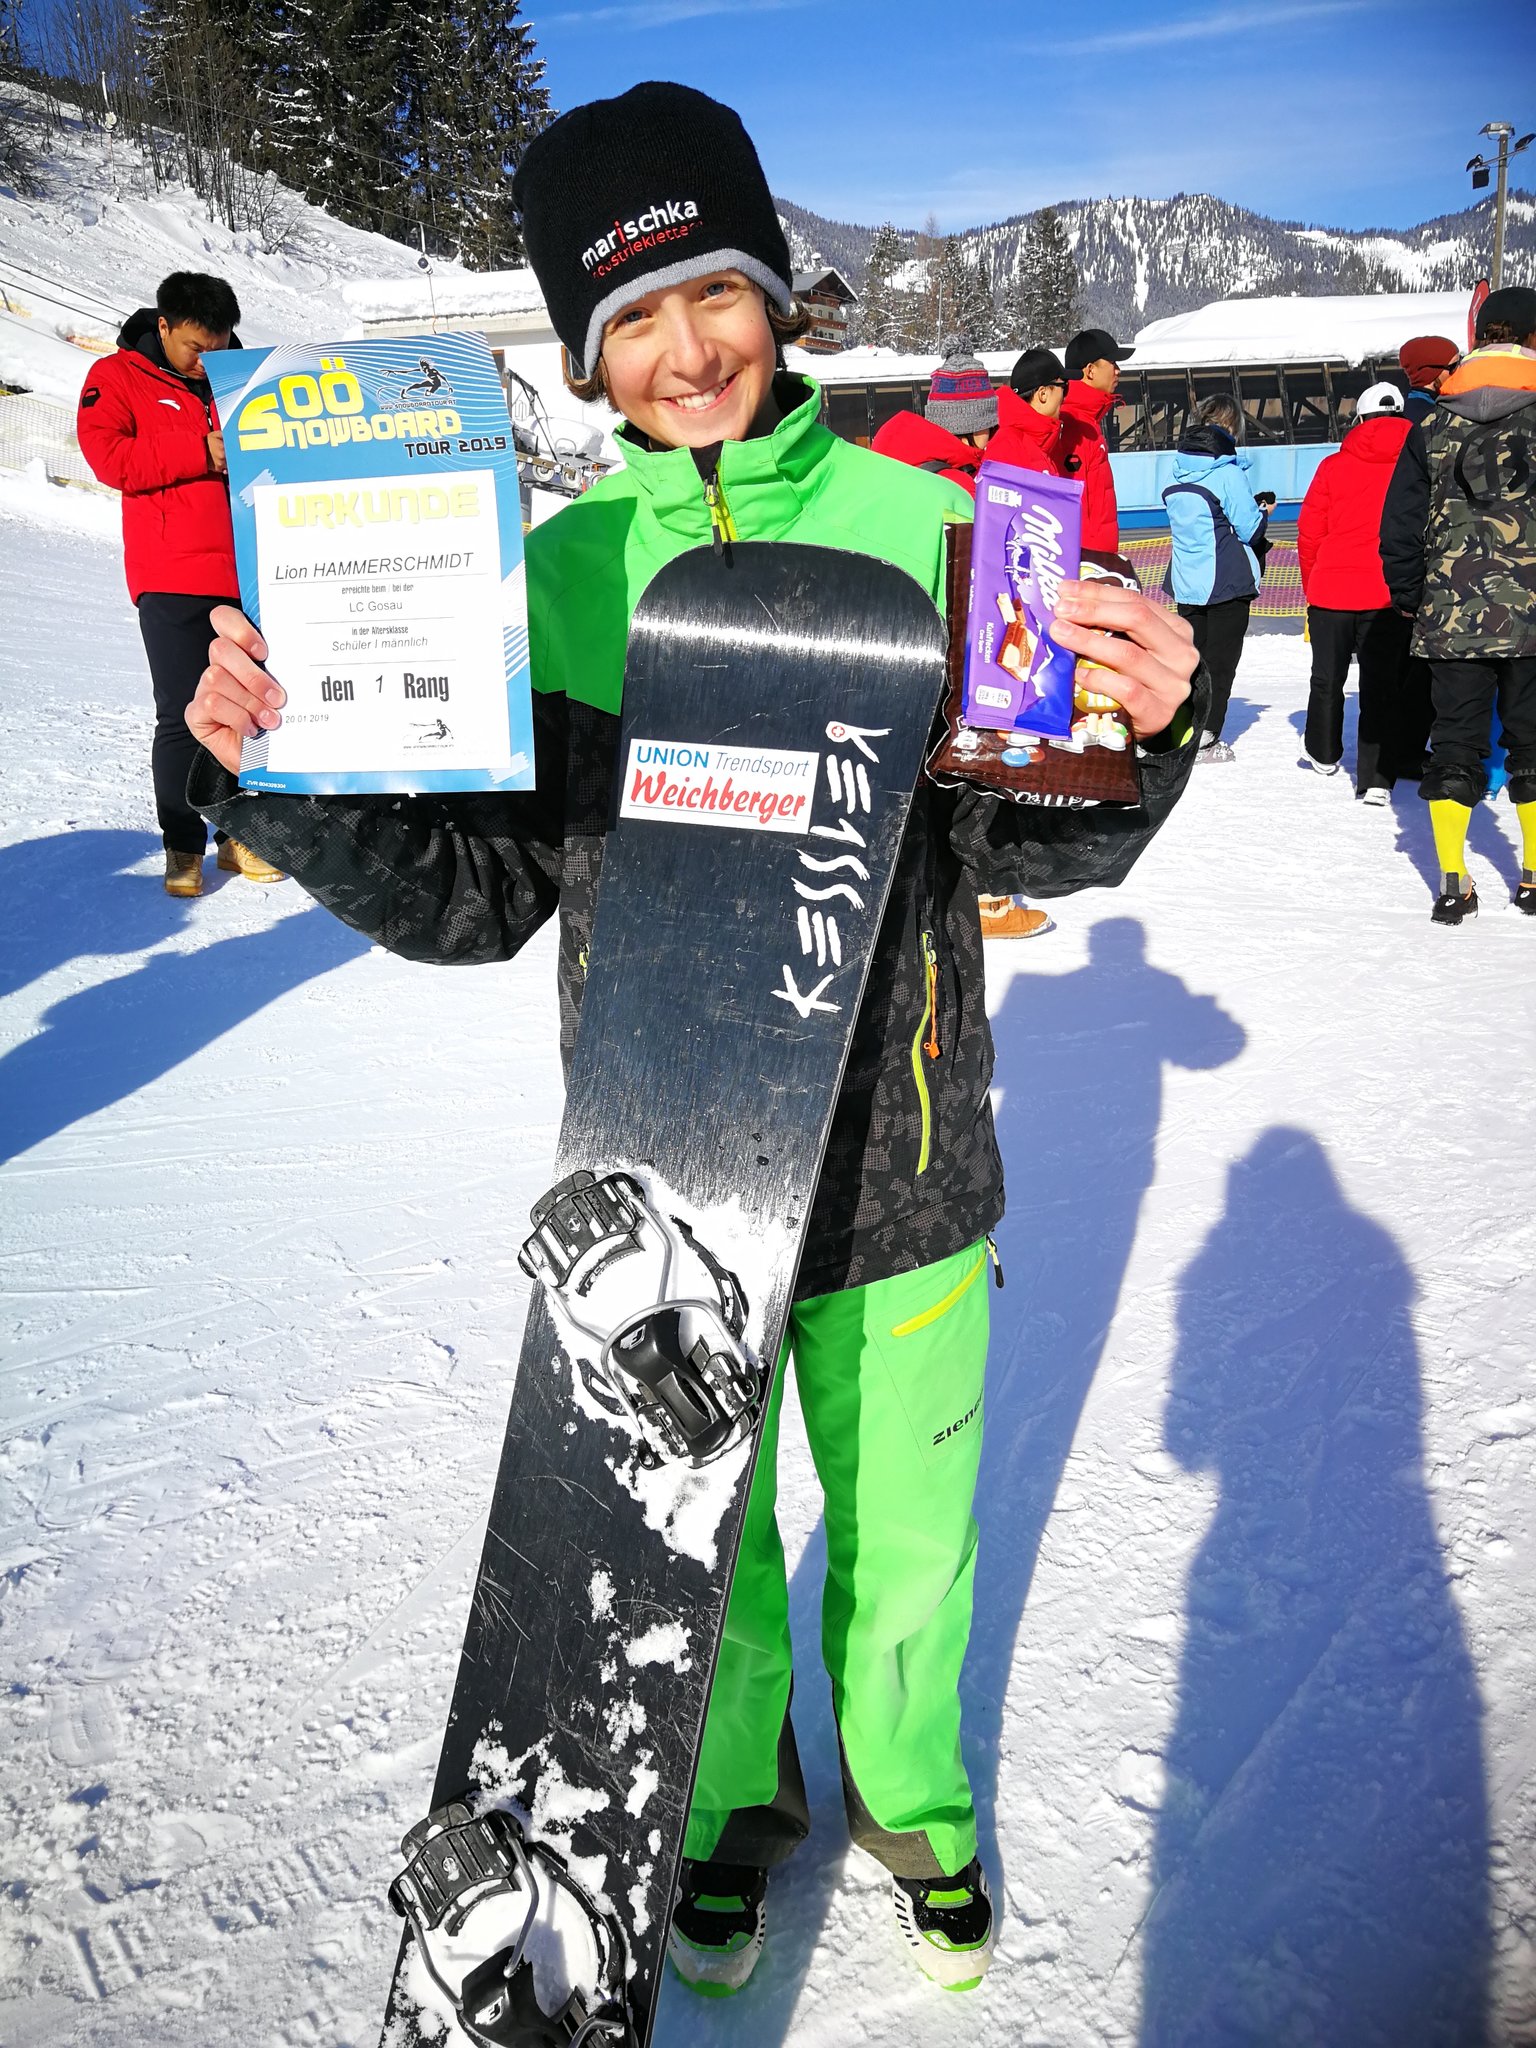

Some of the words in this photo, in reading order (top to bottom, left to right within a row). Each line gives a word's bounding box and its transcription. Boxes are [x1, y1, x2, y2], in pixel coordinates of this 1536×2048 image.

[581, 199, 699, 271] marischka
[404, 440, 451, 458] TOUR
[458, 436, 506, 454] 2019
[278, 484, 480, 528] URKUNDE
[275, 565, 308, 580] Lion
[313, 551, 474, 577] HAMMERSCHMIDT
[1022, 505, 1064, 611] Milka
[342, 585, 370, 594] erreichte
[372, 584, 386, 593] beim
[392, 583, 401, 592] bei
[403, 583, 414, 592] der
[349, 601, 364, 612] LC
[368, 600, 403, 611] Gosau
[332, 638, 371, 651] Schüler
[382, 636, 428, 649] männlich
[359, 626, 370, 635] der
[372, 625, 408, 635] Altersklasse
[321, 675, 354, 702] den
[375, 675, 383, 693] 1
[403, 673, 449, 702] Rang
[637, 746, 709, 768] UNION
[715, 752, 810, 777] Trendsport
[630, 769, 806, 824] Weichberger
[932, 1384, 983, 1446] ziene
